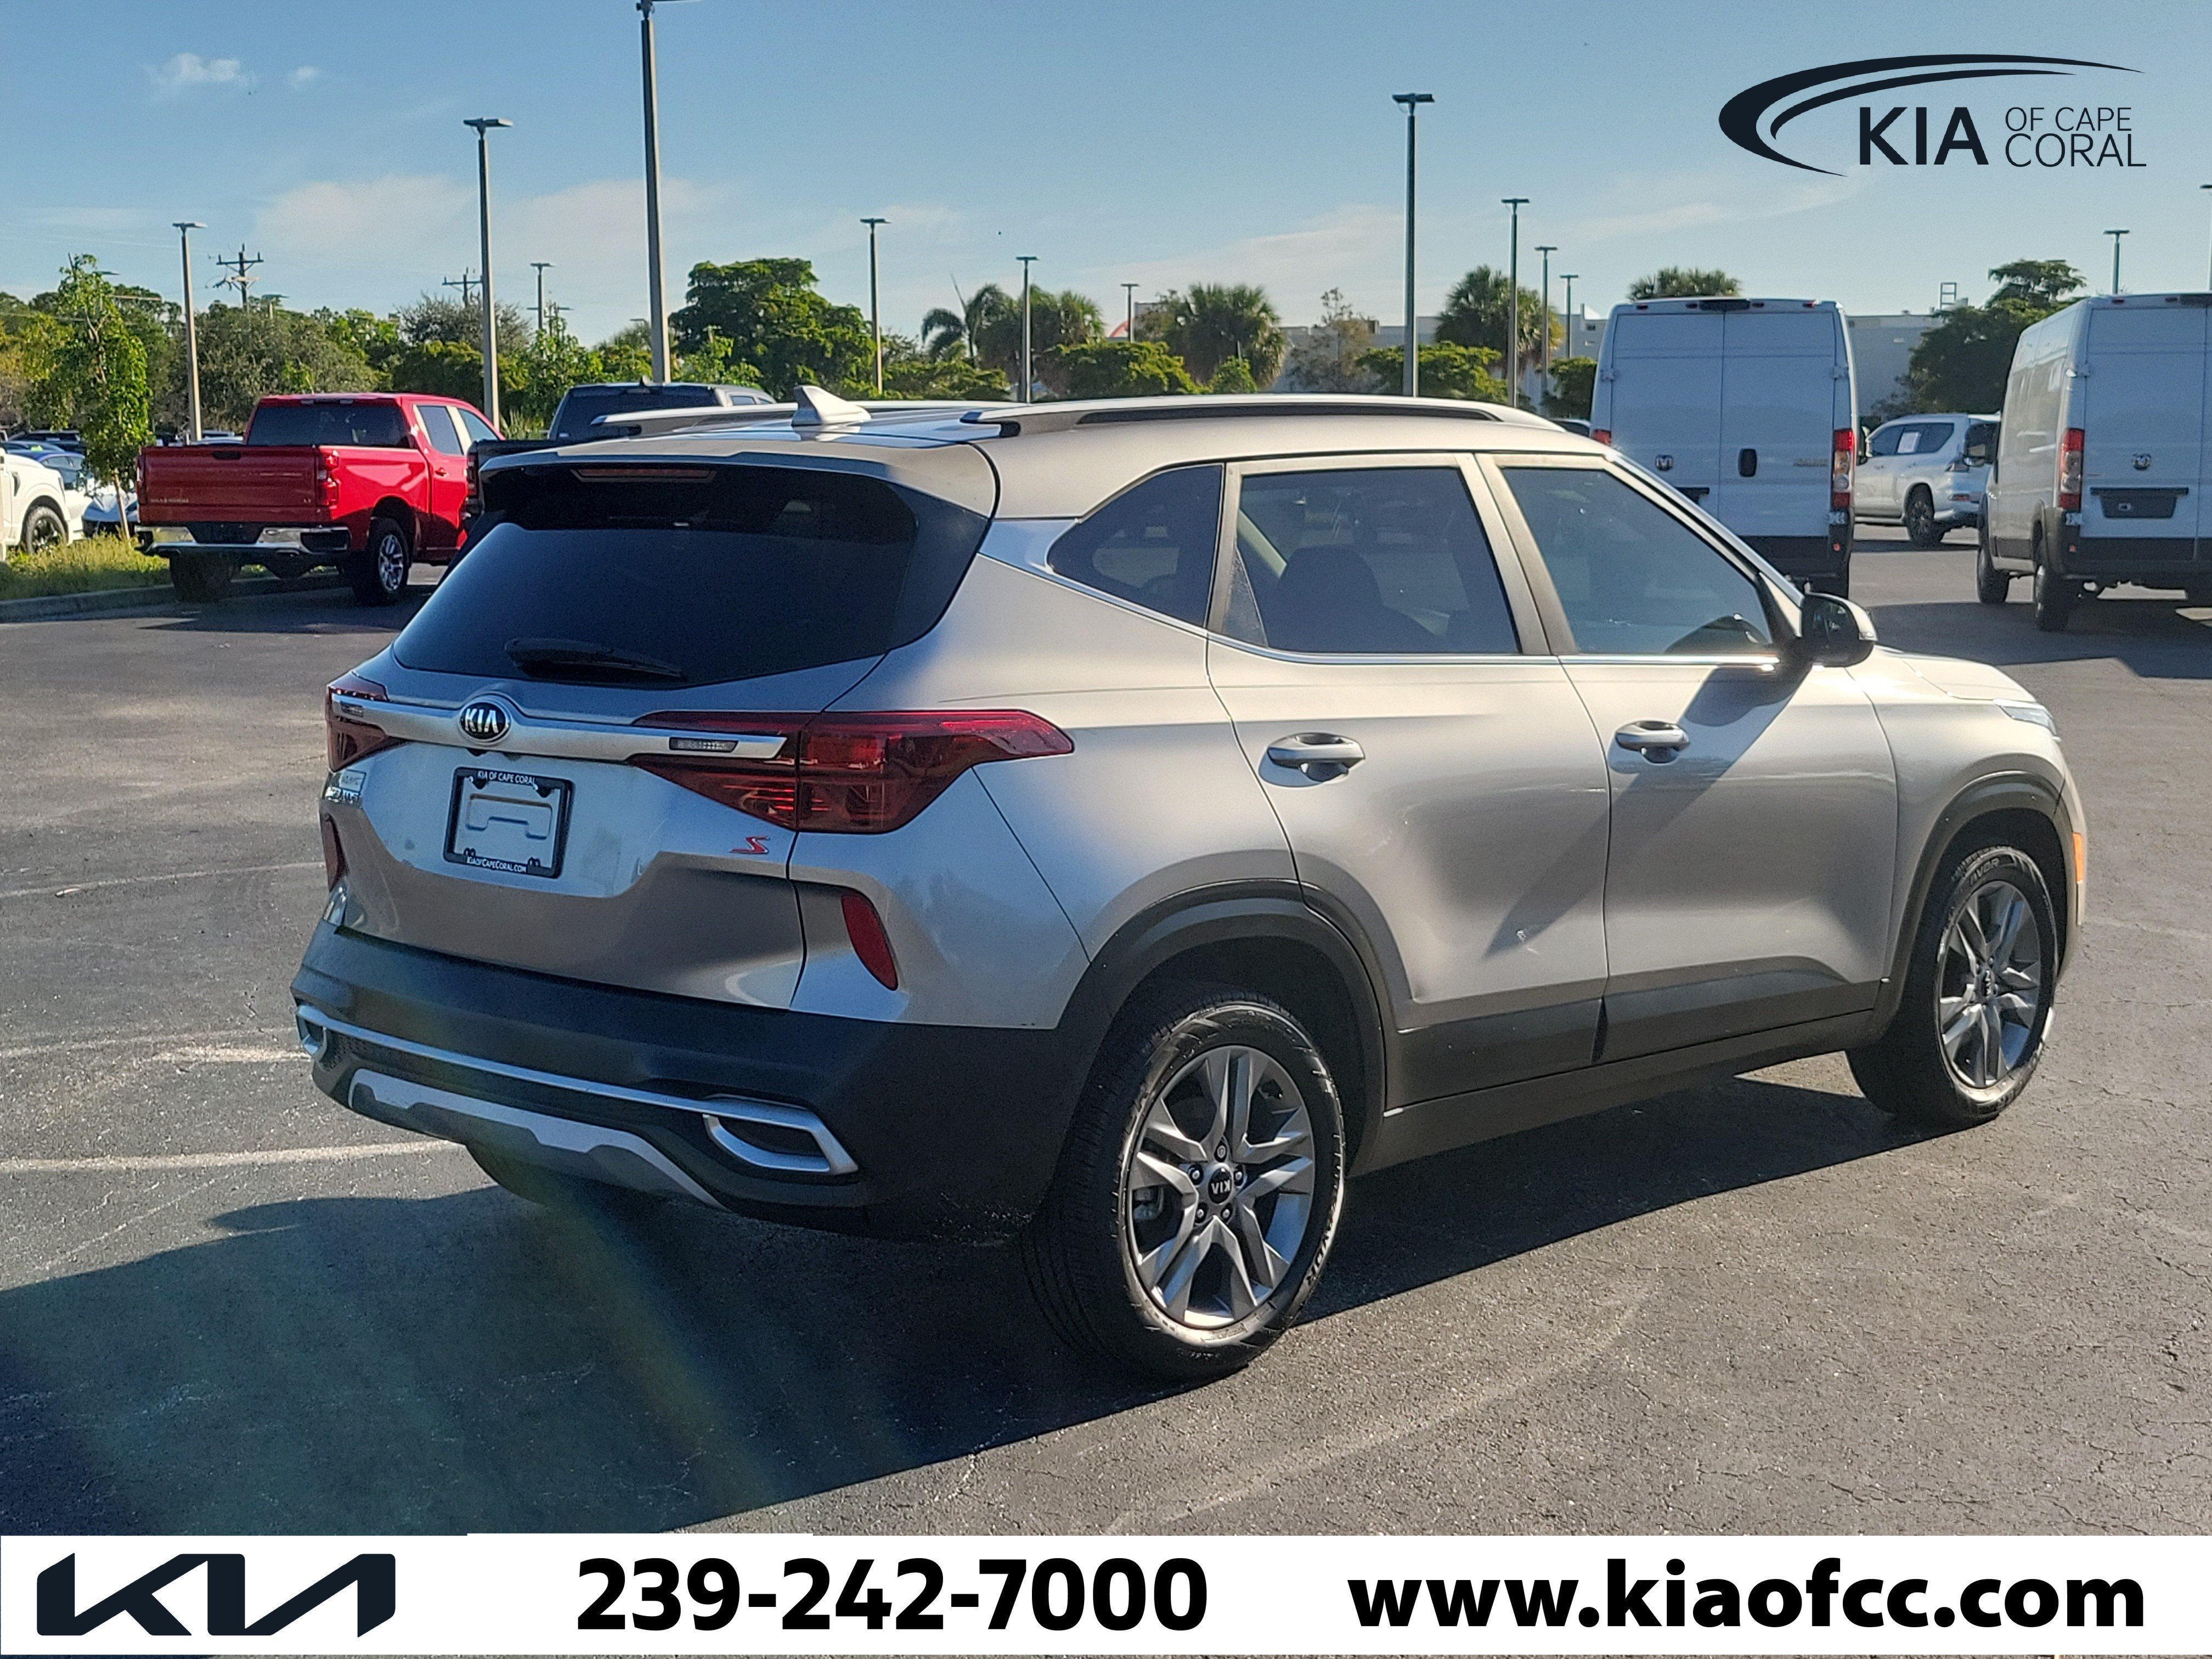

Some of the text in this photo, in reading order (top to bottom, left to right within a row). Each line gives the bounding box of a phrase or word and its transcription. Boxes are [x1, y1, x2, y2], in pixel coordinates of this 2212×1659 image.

[465, 708, 499, 733] KIA
[477, 770, 535, 785] KIA OF CAPE CORAL
[1211, 1180, 1230, 1194] KIA
